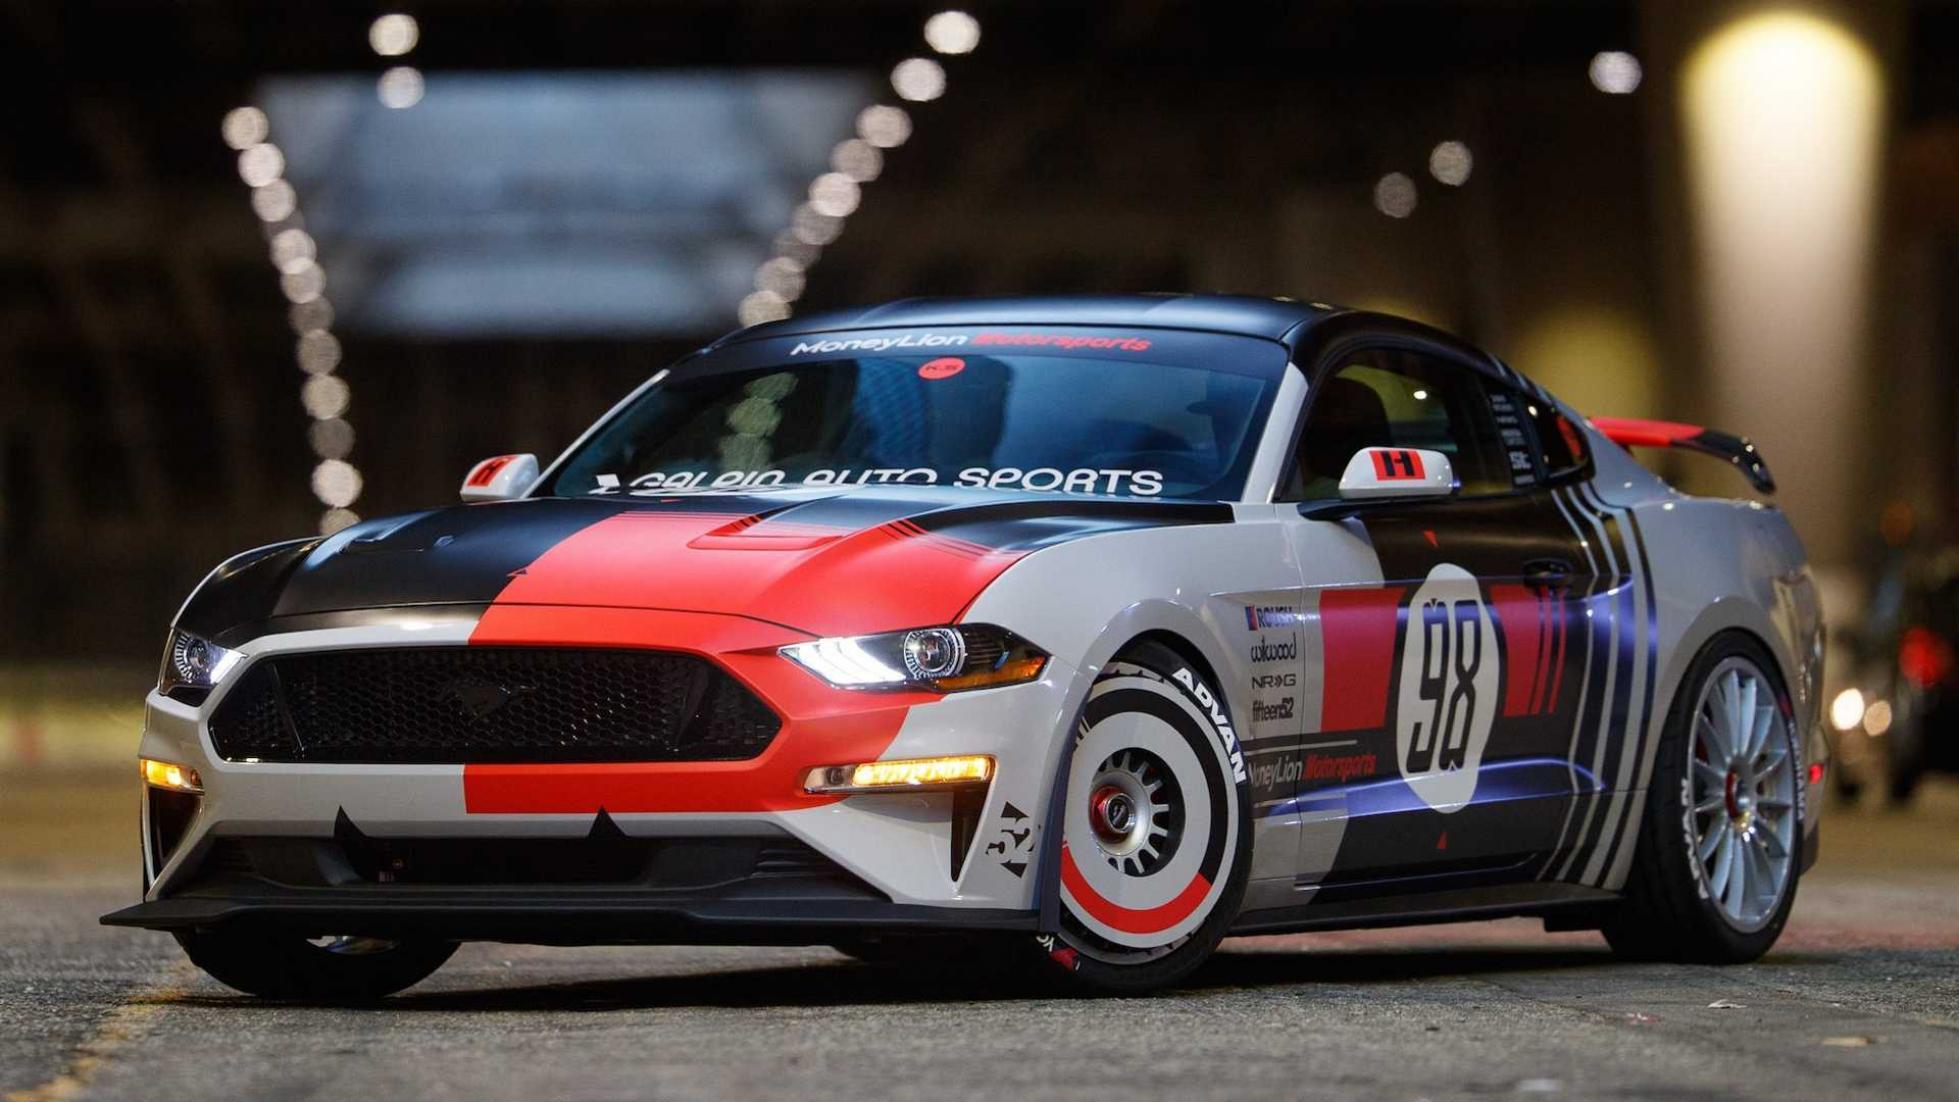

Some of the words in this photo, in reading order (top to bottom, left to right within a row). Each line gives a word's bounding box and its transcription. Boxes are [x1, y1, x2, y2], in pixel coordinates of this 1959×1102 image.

[791, 335, 968, 355] MoneyLion
[954, 468, 1163, 495] SPORTS
[1405, 598, 1482, 774] 98
[1172, 667, 1247, 784] ADVAN
